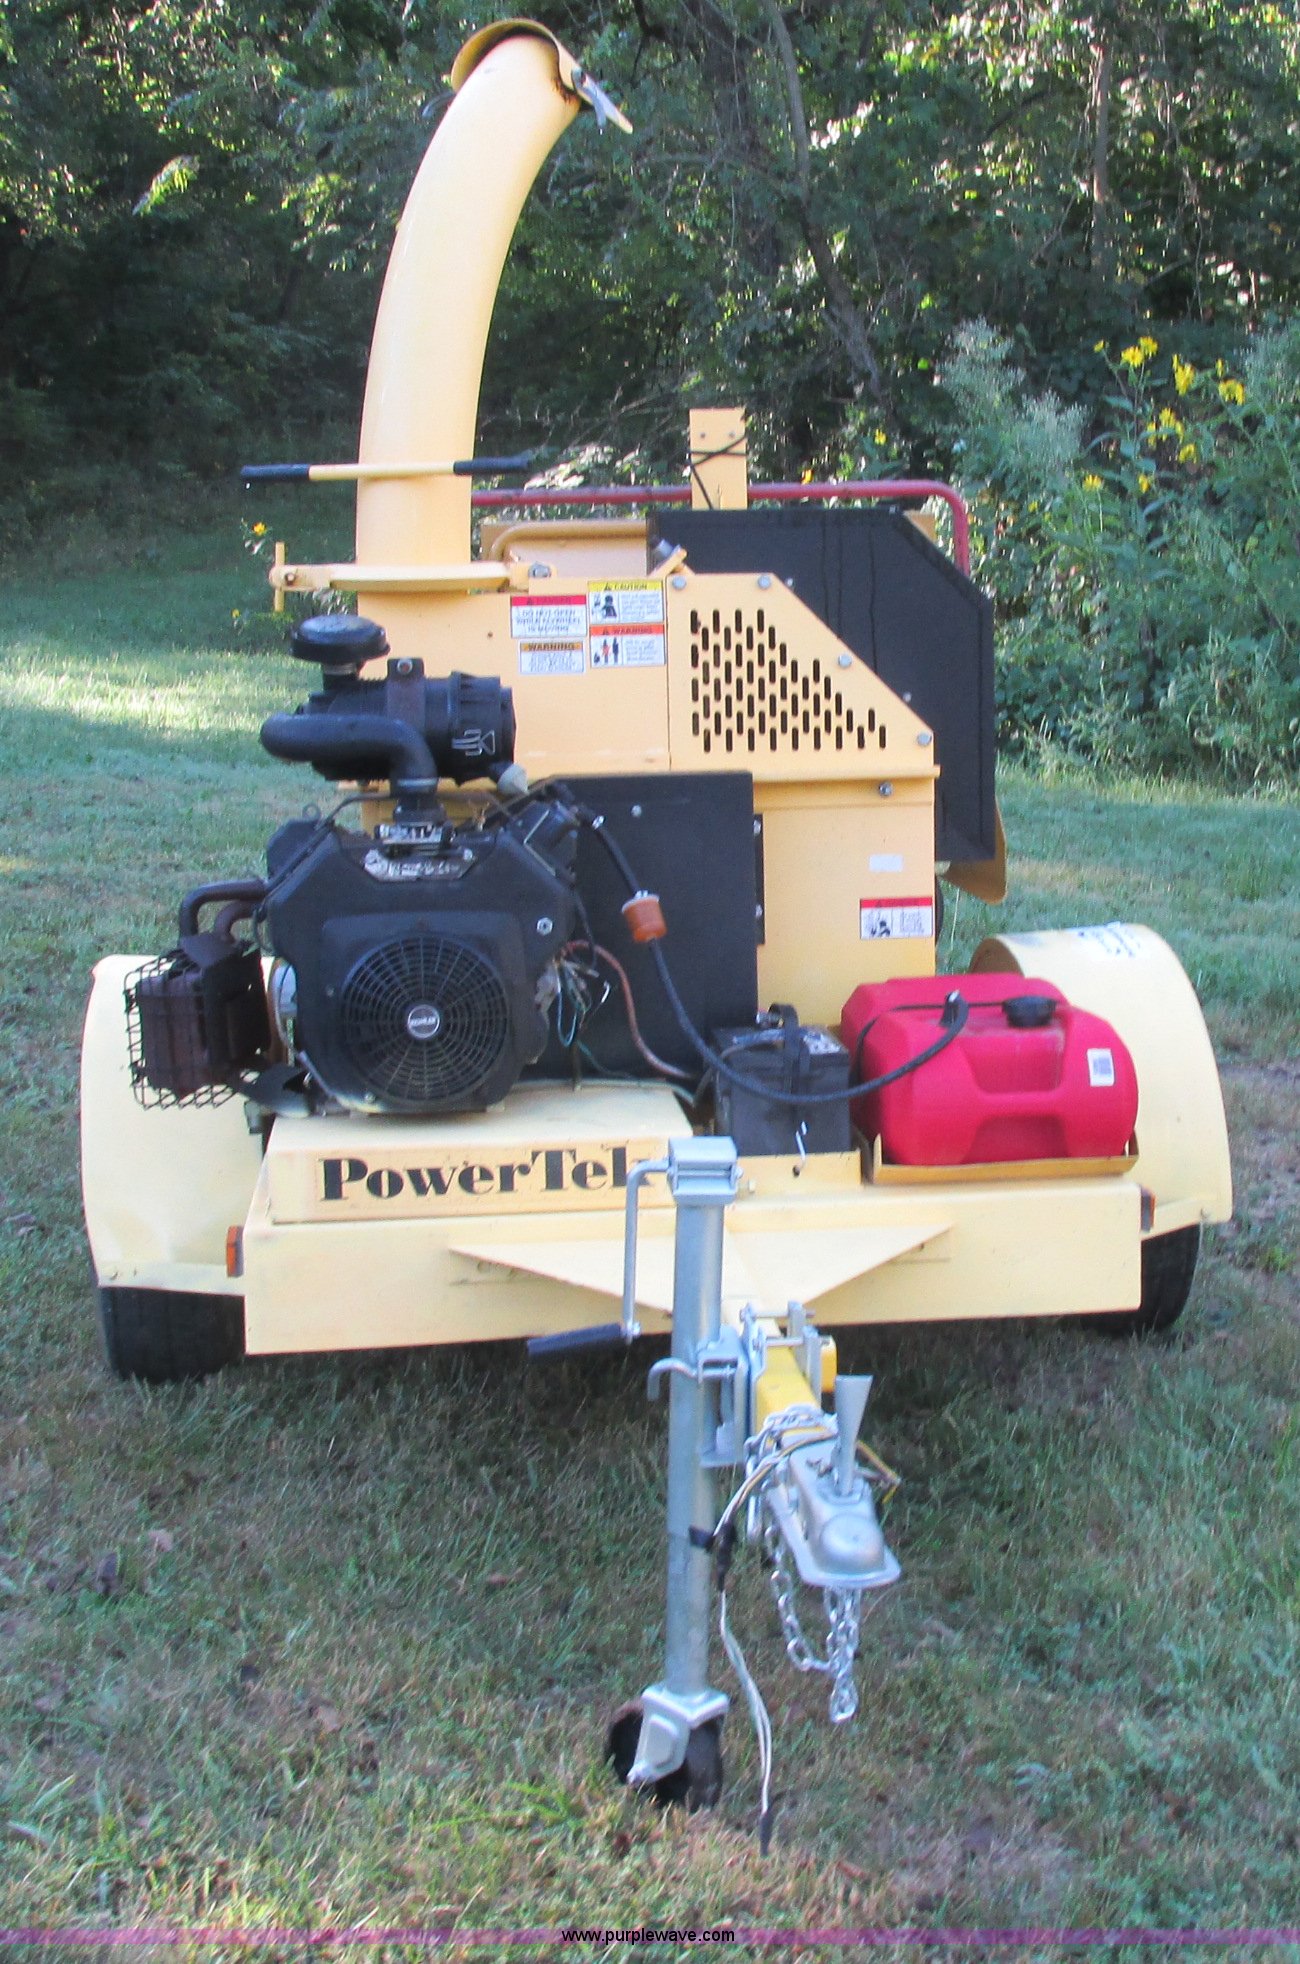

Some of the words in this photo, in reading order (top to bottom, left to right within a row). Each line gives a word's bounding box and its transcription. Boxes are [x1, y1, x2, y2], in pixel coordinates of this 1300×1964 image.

[614, 582, 648, 590] CAUTION
[613, 626, 653, 634] WARNING
[528, 642, 576, 651] WARNING
